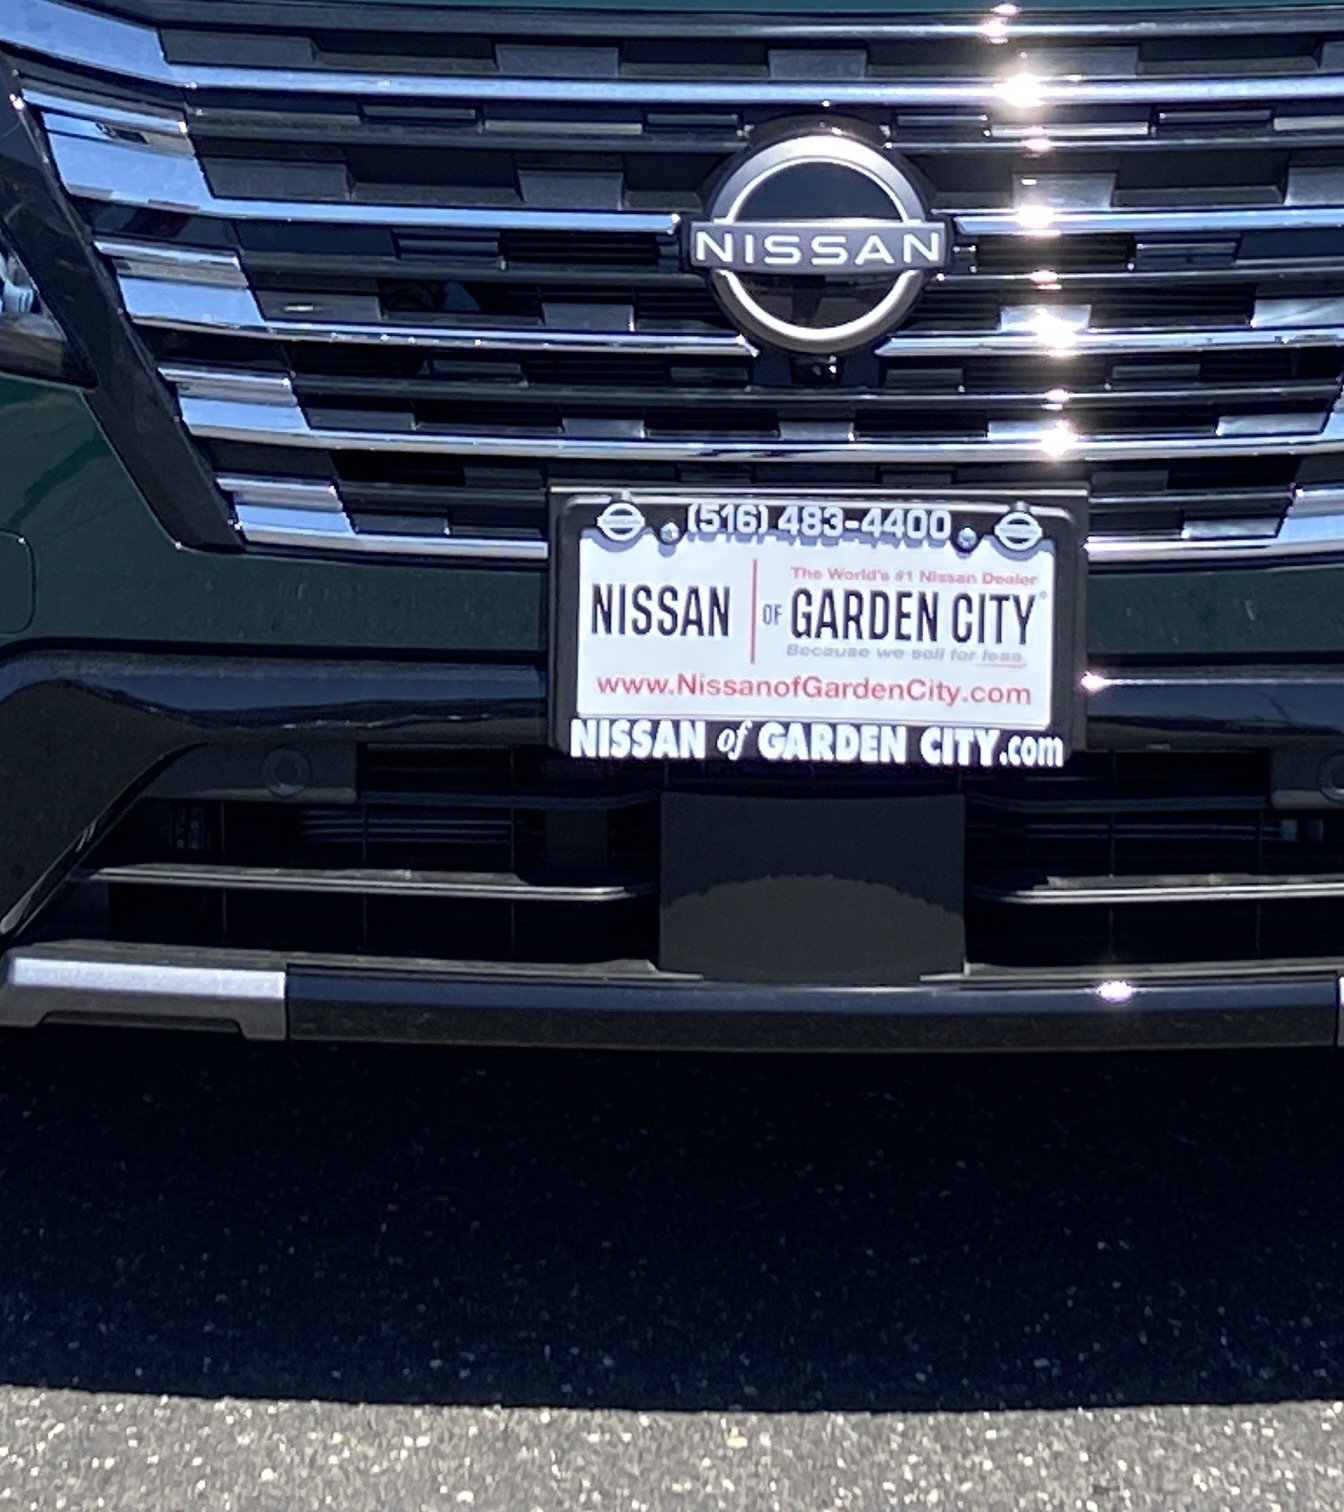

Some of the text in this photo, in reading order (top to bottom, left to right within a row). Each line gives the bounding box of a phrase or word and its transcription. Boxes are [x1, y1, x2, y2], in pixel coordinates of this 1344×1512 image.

[695, 231, 940, 266] NISSAN
[687, 502, 953, 539] (516) 483-4400
[790, 566, 1038, 587] The World's #1 Nissan Dealer
[591, 583, 1036, 645] NISSAN OF GARDEN CITY
[786, 643, 871, 659] Because
[877, 647, 907, 660] we
[912, 646, 946, 661] sell
[950, 647, 977, 662] for
[596, 672, 1032, 706] www.NissanofGardenCity.com
[570, 718, 1065, 768] NISSAN of GARDEN CITY.com
